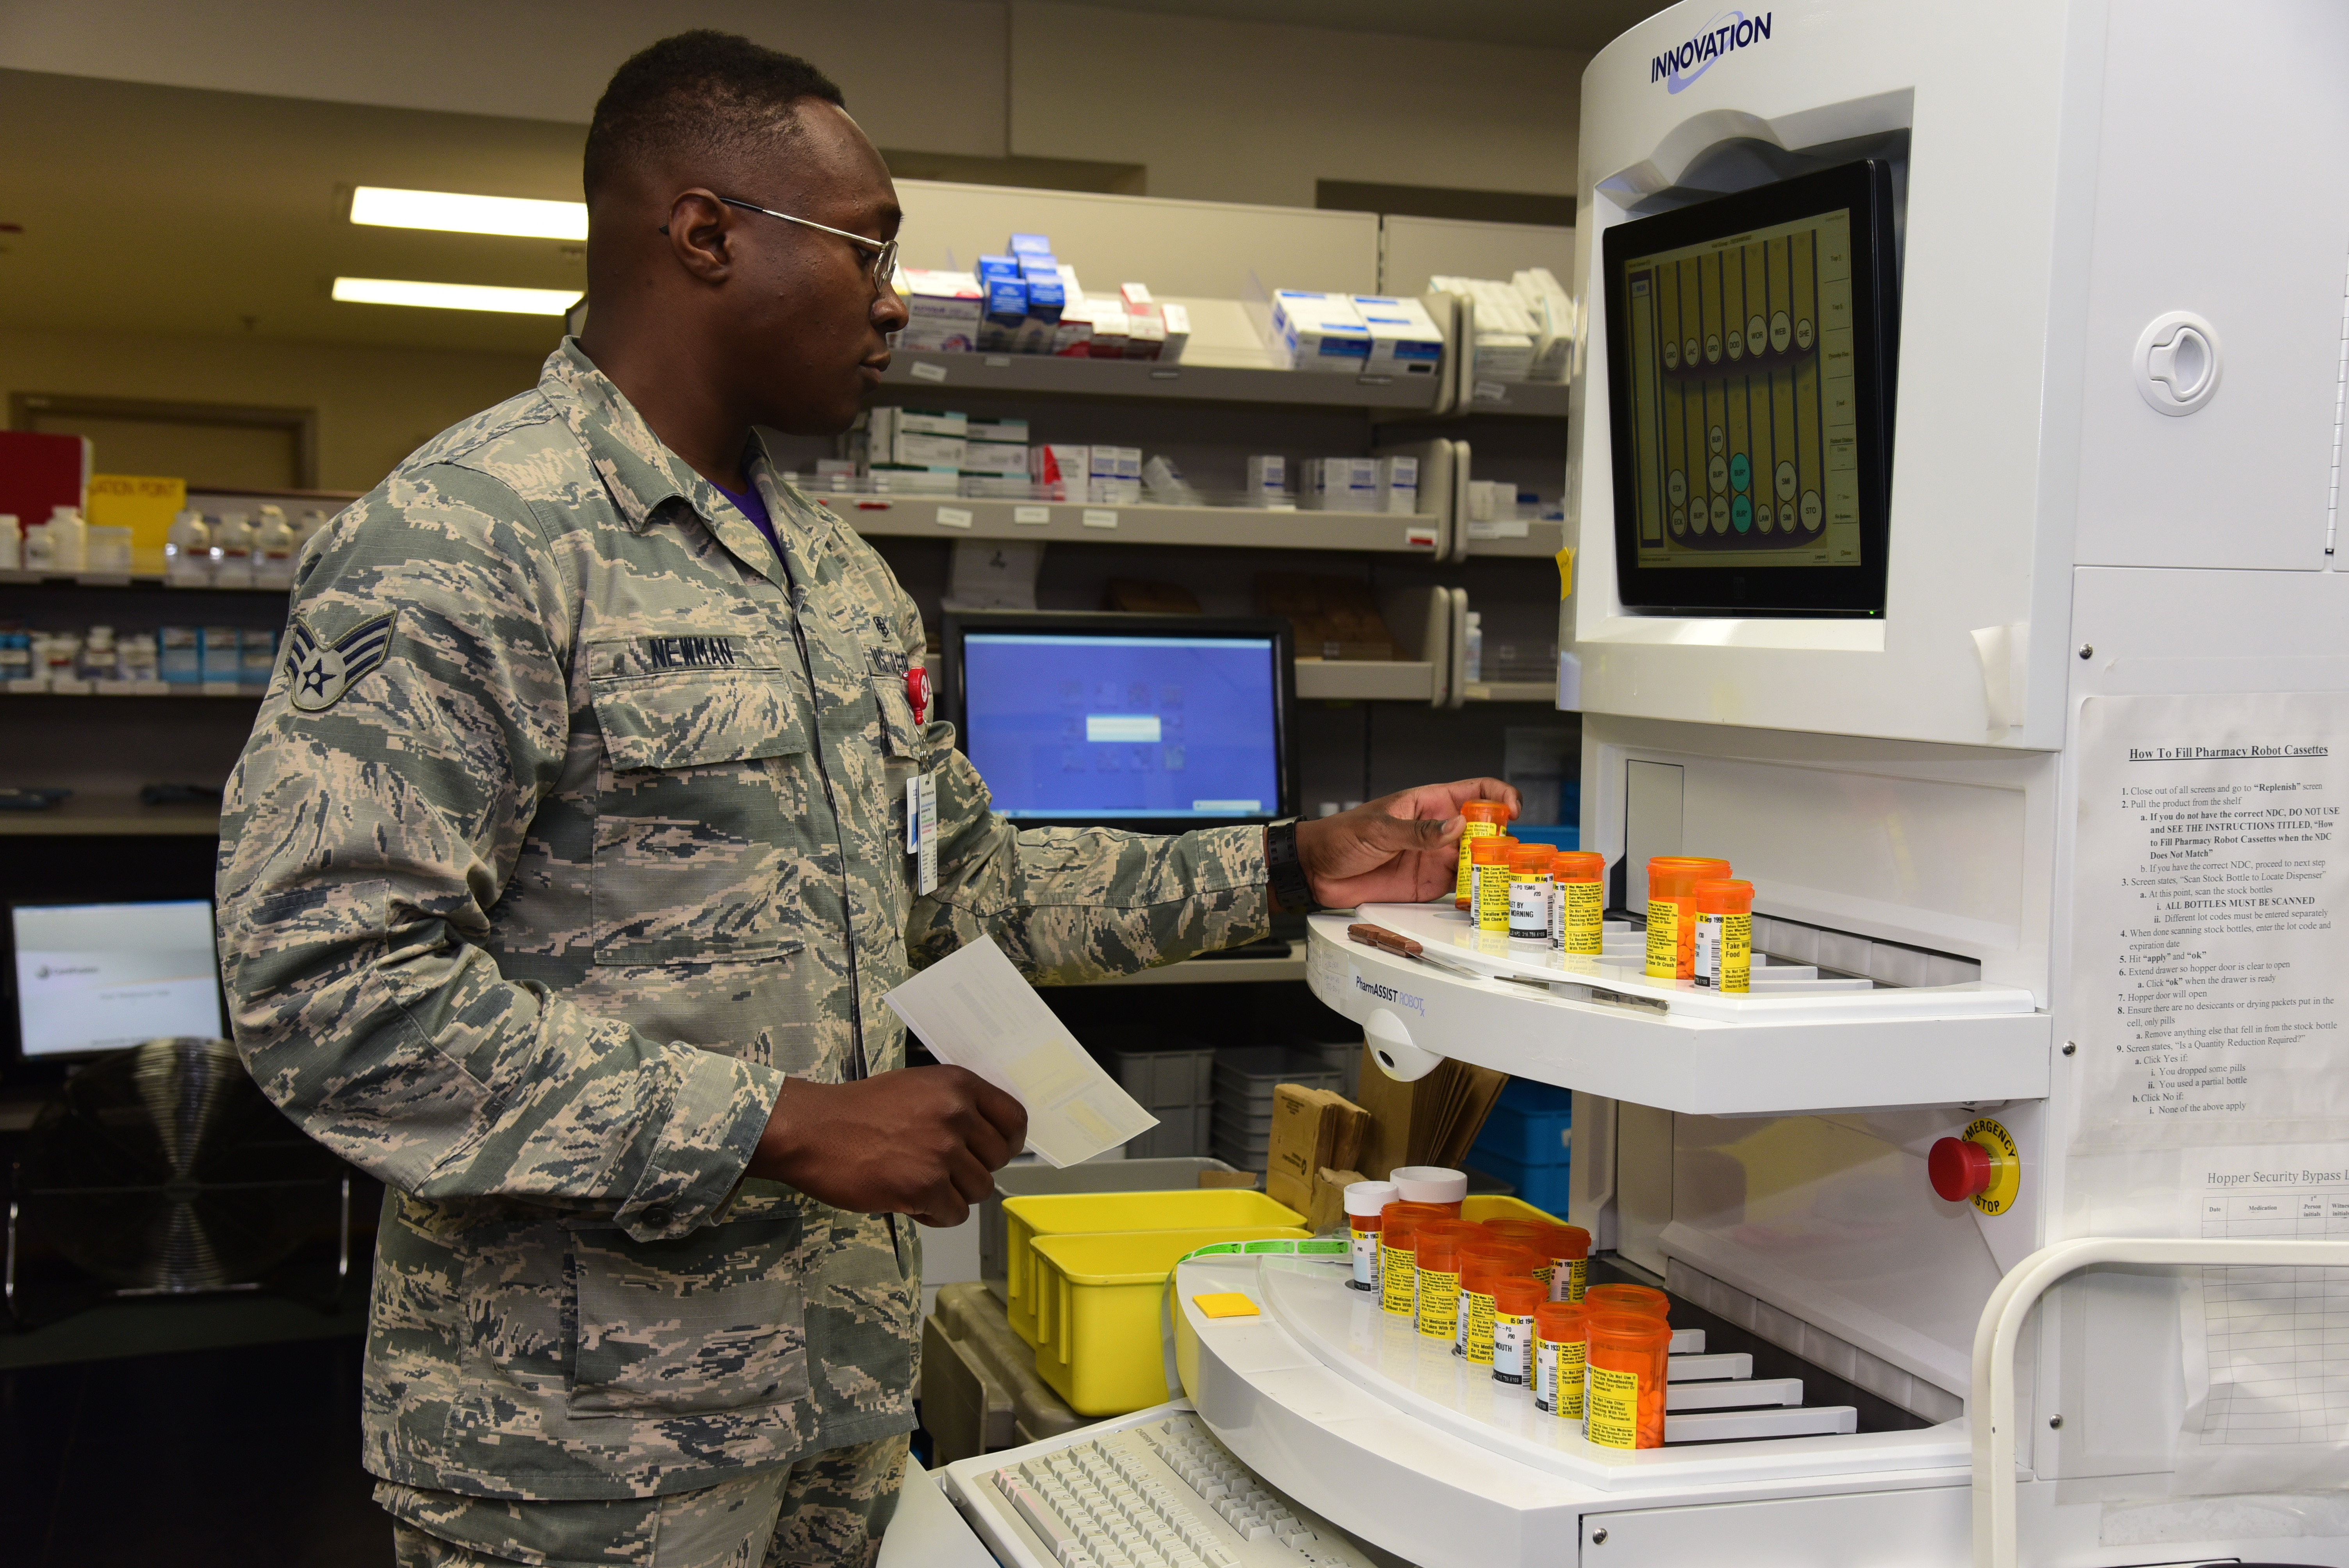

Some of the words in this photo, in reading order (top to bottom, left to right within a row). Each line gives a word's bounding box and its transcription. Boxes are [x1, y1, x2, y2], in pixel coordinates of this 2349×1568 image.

[1651, 12, 1772, 84] INNOVATION
[650, 638, 735, 668] NEWMAN
[2130, 748, 2153, 759] How
[2157, 748, 2172, 758] To
[2175, 747, 2192, 758] Fill
[2195, 747, 2248, 757] Pharmacy
[2251, 745, 2281, 755] Robot
[2285, 745, 2328, 755] Cassettes
[2131, 787, 2153, 795] Close
[2169, 786, 2178, 794] of
[2179, 786, 2189, 794] all
[2217, 784, 2230, 792] and
[2232, 786, 2242, 794] go
[2130, 800, 2146, 808] Pull
[2163, 799, 2190, 809] product
[2192, 798, 2208, 806] from
[2210, 797, 2221, 805] the
[2223, 796, 2242, 805] shelf
[2150, 813, 2158, 821] If
[2176, 812, 2185, 820] do
[2289, 808, 2303, 816] DO
[2304, 807, 2321, 816] NOT
[2323, 807, 2340, 815] USE
[2150, 825, 2165, 834] and
[2167, 825, 2183, 833] SEE
[2185, 824, 2203, 832] THE
[2205, 822, 2275, 831] INSTRUCTIONS
[2160, 838, 2173, 846] Fill
[2174, 837, 2212, 846] Pharmacy
[2214, 836, 2239, 844] Robot
[2315, 832, 2331, 841] NDC
[2170, 850, 2183, 859] Not
[2165, 902, 2182, 910] ALL
[2184, 900, 2226, 909] BOTTLES
[2229, 899, 2256, 907] MUST
[2259, 898, 2269, 906] BE
[2271, 896, 2315, 905] SCANNED
[2129, 955, 2141, 963] Hit
[2173, 951, 2185, 960] and
[1356, 976, 1398, 1002] PharmASSIST
[2208, 1172, 2250, 1186] Hopper
[2253, 1171, 2299, 1184] Security
[2302, 1170, 2341, 1183] Bypass
[1975, 1195, 1999, 1212] STOP
[1495, 1342, 1512, 1352] MOUTH
[1135, 1429, 1154, 1443] CHERRY
